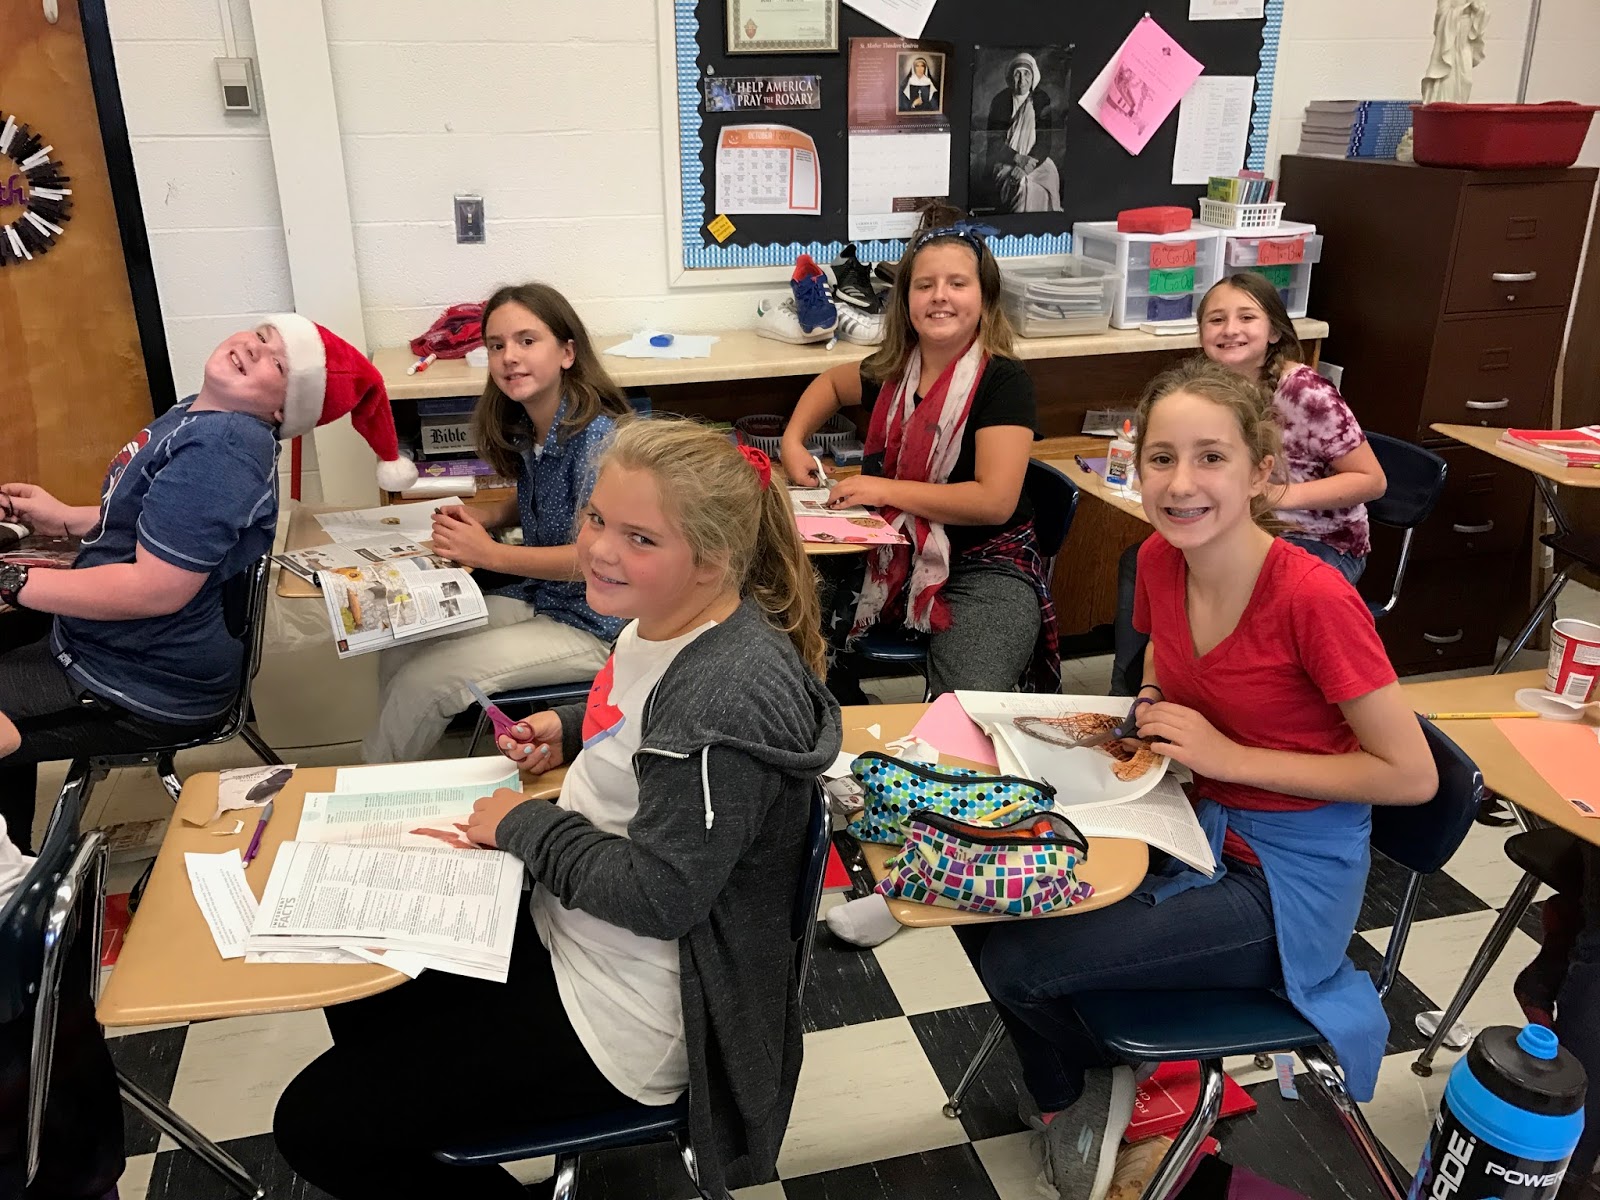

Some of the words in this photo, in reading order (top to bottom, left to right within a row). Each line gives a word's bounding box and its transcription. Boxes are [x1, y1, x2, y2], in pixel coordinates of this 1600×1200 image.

[737, 81, 764, 93] HELP
[766, 80, 813, 93] AMERICA
[737, 93, 763, 107] PRAY
[763, 96, 774, 104] THE
[775, 93, 813, 106] ROSARY
[747, 131, 773, 140] OCTOBER
[430, 427, 467, 444] Bible
[278, 897, 296, 928] FACTS
[1428, 1130, 1475, 1200] ADE
